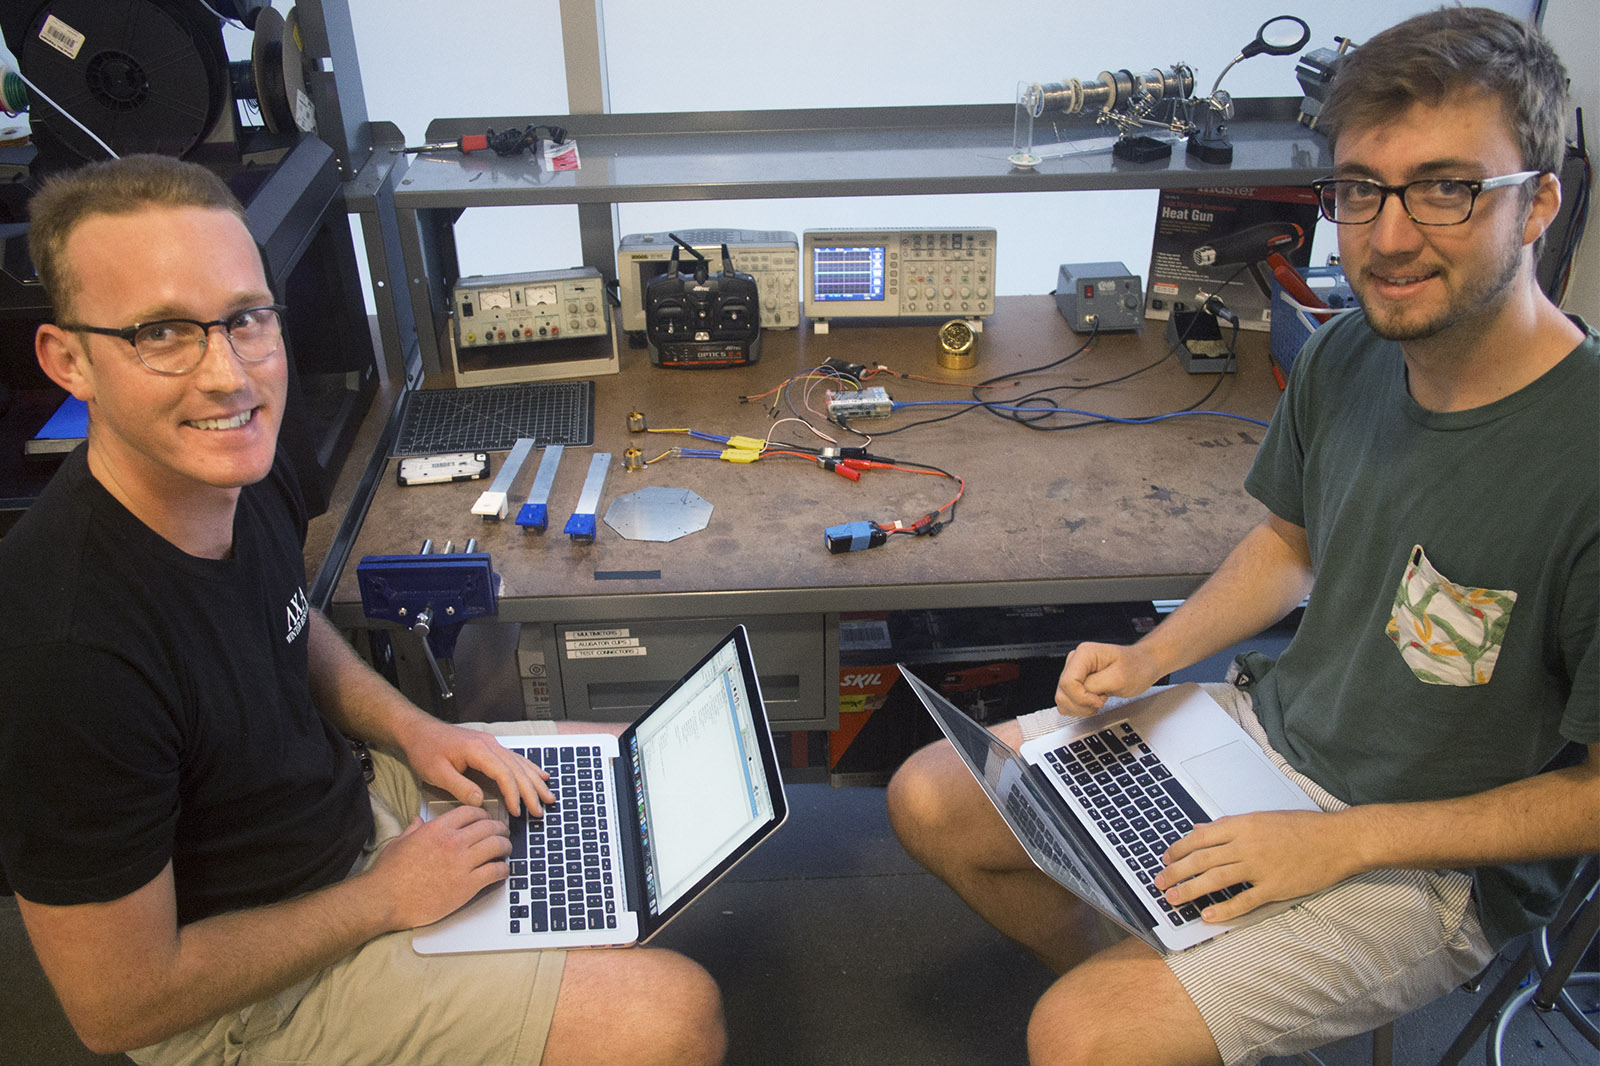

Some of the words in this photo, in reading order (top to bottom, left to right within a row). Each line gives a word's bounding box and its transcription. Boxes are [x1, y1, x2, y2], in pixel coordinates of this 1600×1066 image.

[1162, 206, 1189, 220] Heat
[1192, 209, 1214, 222] Gun
[839, 673, 882, 688] SKIL
